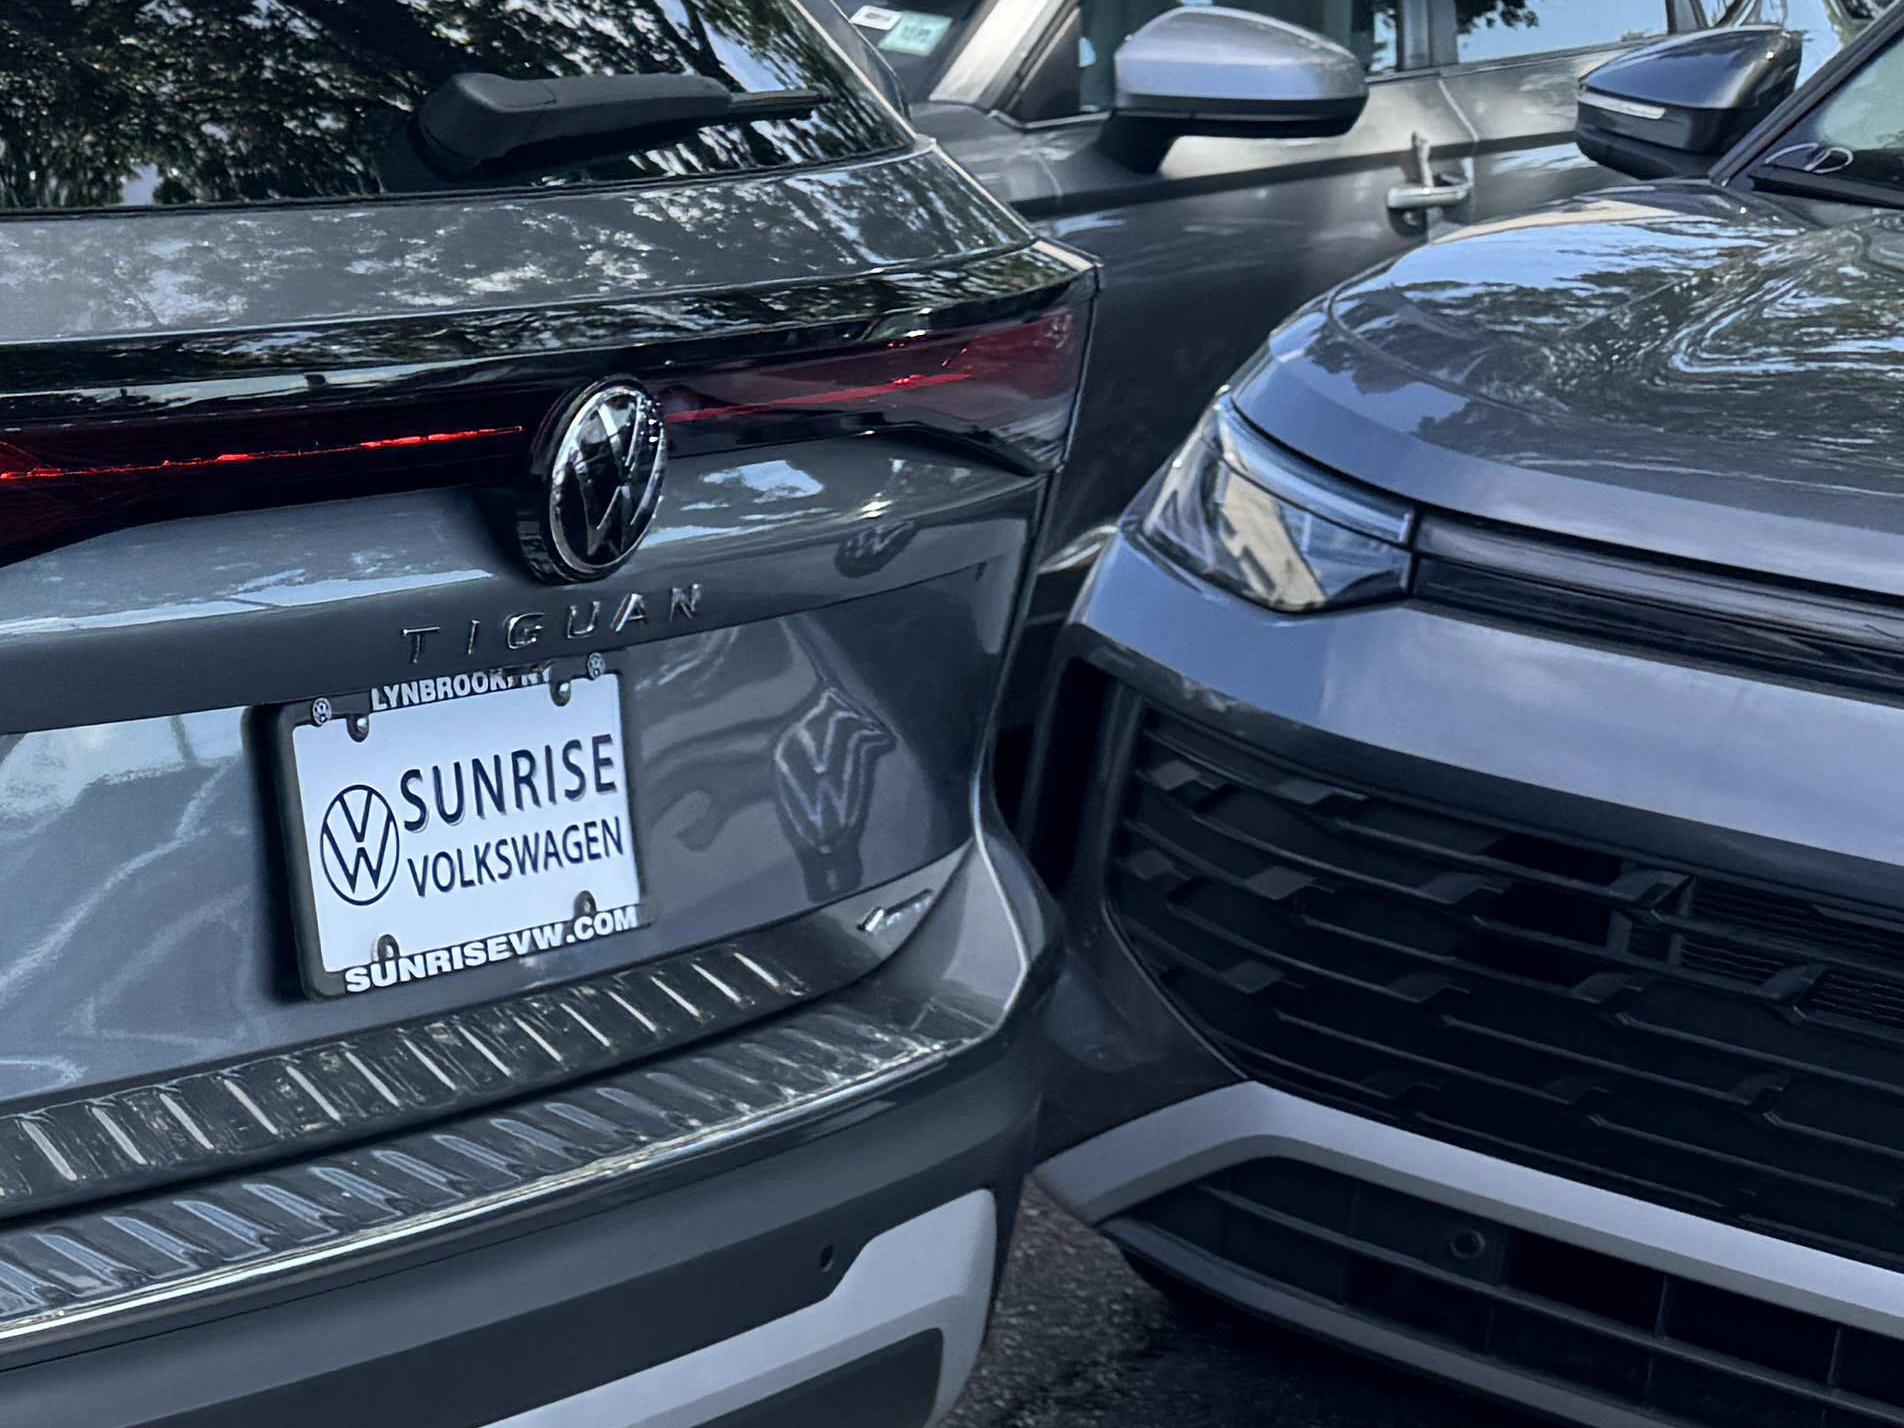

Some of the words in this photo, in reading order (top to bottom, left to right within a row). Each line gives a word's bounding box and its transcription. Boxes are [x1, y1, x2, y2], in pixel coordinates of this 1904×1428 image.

[401, 582, 705, 664] TIGUAN
[400, 733, 618, 832] SUNRISE
[406, 815, 625, 899] VOLKSWAGEN
[345, 906, 638, 993] SUNRISEVW.COM
